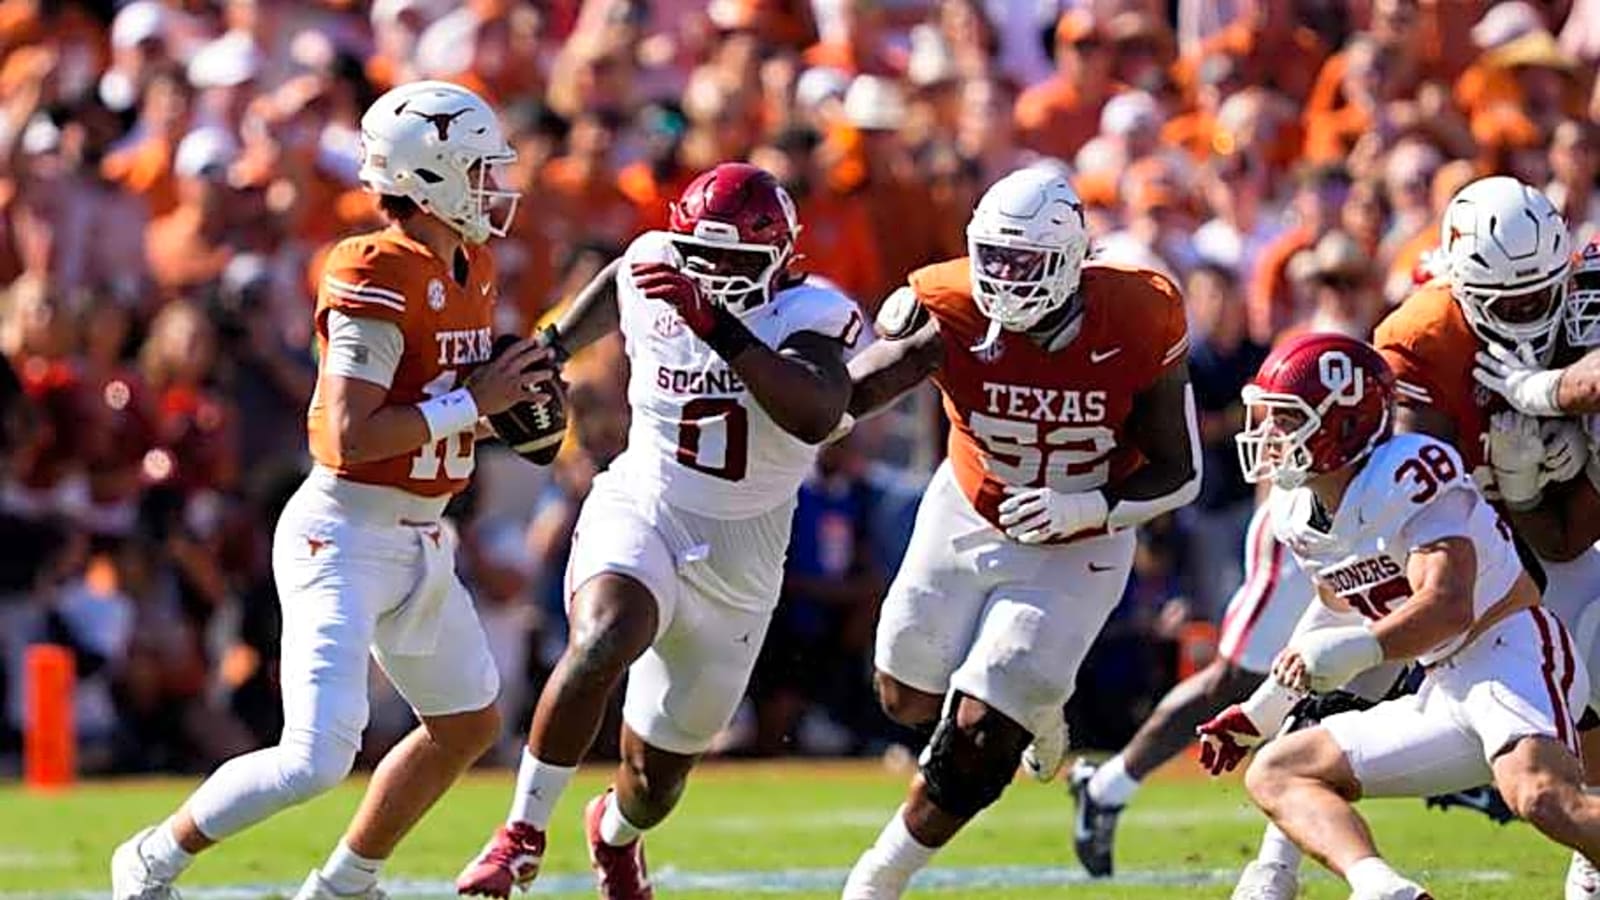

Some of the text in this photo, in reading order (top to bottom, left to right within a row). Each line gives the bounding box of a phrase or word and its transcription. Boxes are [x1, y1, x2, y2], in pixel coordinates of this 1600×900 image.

[657, 365, 745, 395] SOONE
[982, 382, 1107, 422] TEXAS
[1318, 351, 1364, 406] OU
[677, 398, 748, 482] 0
[969, 411, 1117, 494] 52
[1394, 444, 1457, 503] 38
